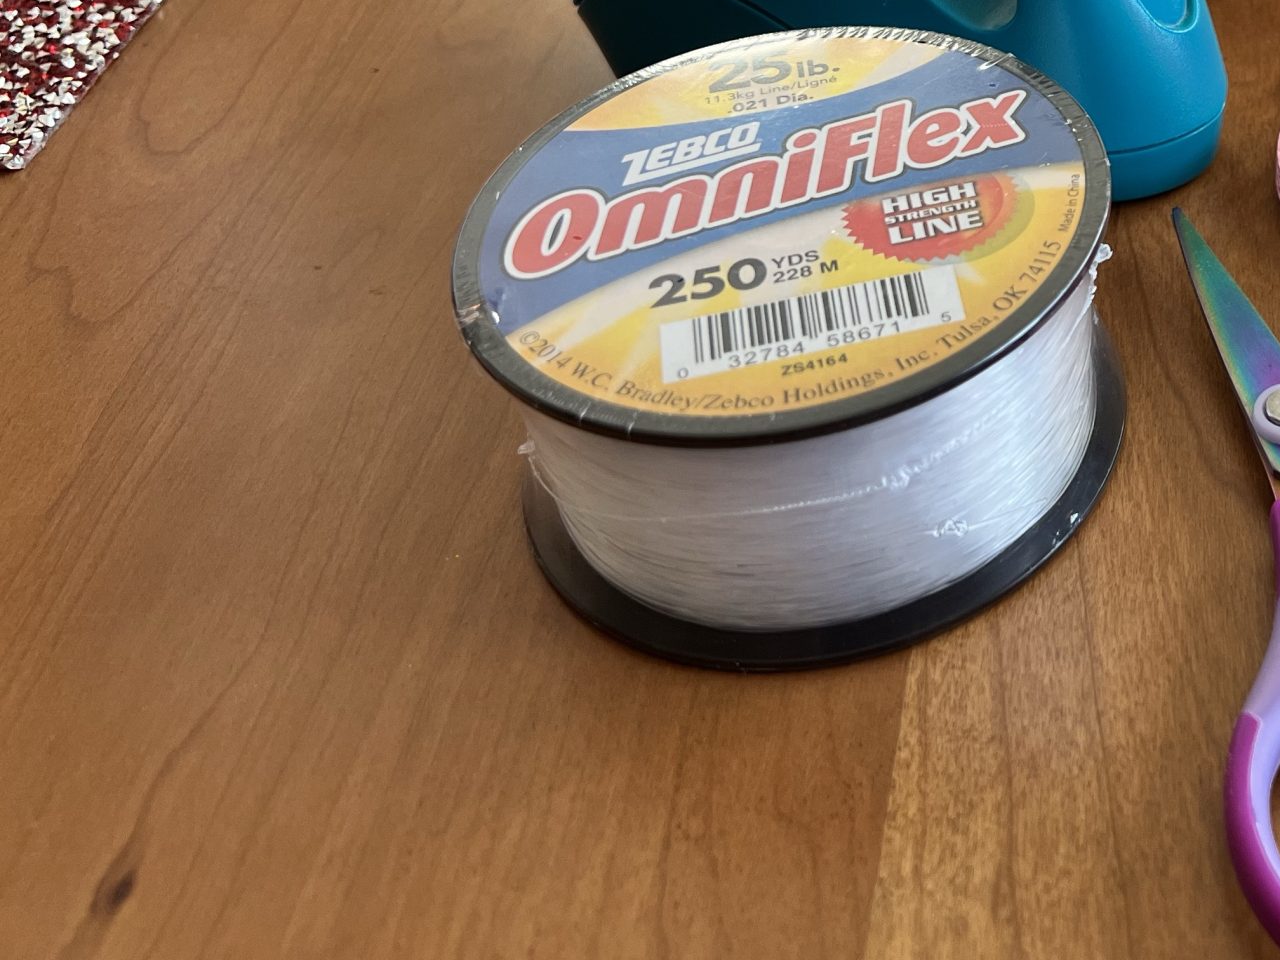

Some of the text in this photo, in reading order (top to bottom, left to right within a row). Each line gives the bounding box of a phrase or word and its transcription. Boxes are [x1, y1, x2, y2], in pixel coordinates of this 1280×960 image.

[708, 49, 841, 93] 25 lb.
[704, 91, 755, 105] 11.3kg
[728, 92, 814, 114] .021 Dia.
[621, 121, 763, 187] ZEBCO
[503, 89, 1027, 280] OmniFlex
[882, 180, 977, 214] HIGH
[884, 198, 978, 225] STRENGTH
[1058, 173, 1081, 233] Made in China
[888, 212, 984, 245] LINE
[771, 248, 820, 270] YDS
[772, 259, 839, 284] 228 M
[648, 257, 768, 309] 250
[519, 330, 573, 370] ©2014
[572, 362, 610, 392] W.C.
[616, 377, 775, 412] Bradley/Zebco
[992, 285, 1027, 312] OK
[1019, 240, 1062, 283] 74115
[677, 311, 952, 379] 0 32784 58671 5
[781, 352, 849, 376] ZS4164
